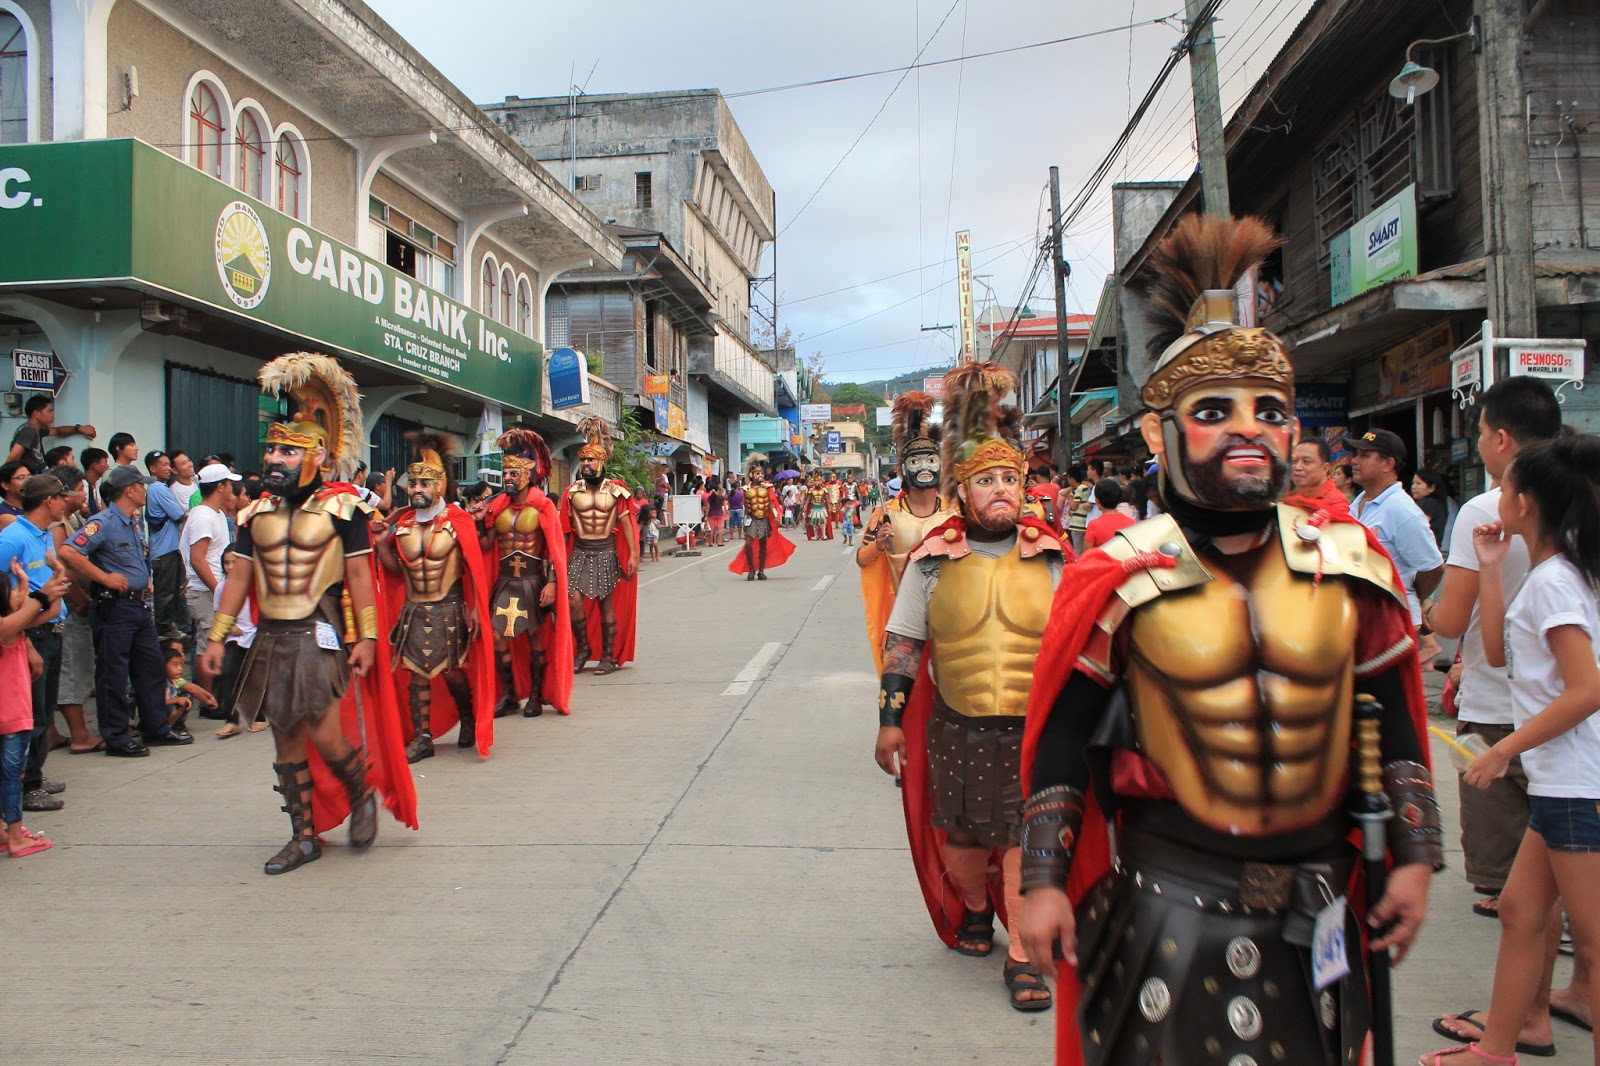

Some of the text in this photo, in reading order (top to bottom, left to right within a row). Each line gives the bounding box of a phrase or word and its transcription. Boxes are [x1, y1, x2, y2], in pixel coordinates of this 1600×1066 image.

[234, 203, 259, 225] BANK
[216, 217, 225, 263] CARD
[1368, 217, 1399, 251] SMART
[1375, 249, 1400, 270] Buddy
[232, 292, 255, 308] 1997
[286, 227, 512, 363] CARD BANK, Inc.
[374, 315, 380, 326] A
[381, 317, 417, 340] Microfinance
[420, 334, 442, 350] Oriented
[442, 343, 455, 356] Rural
[455, 348, 468, 361] Bank
[18, 353, 50, 369] GCASH
[383, 332, 461, 373] STA. CRUZ BRANCH
[1519, 353, 1564, 366] REYNOSO
[20, 368, 49, 382] REMIT
[398, 354, 402, 363] A
[402, 357, 422, 369] member
[427, 365, 440, 376] CARD
[1296, 397, 1345, 408] SMART
